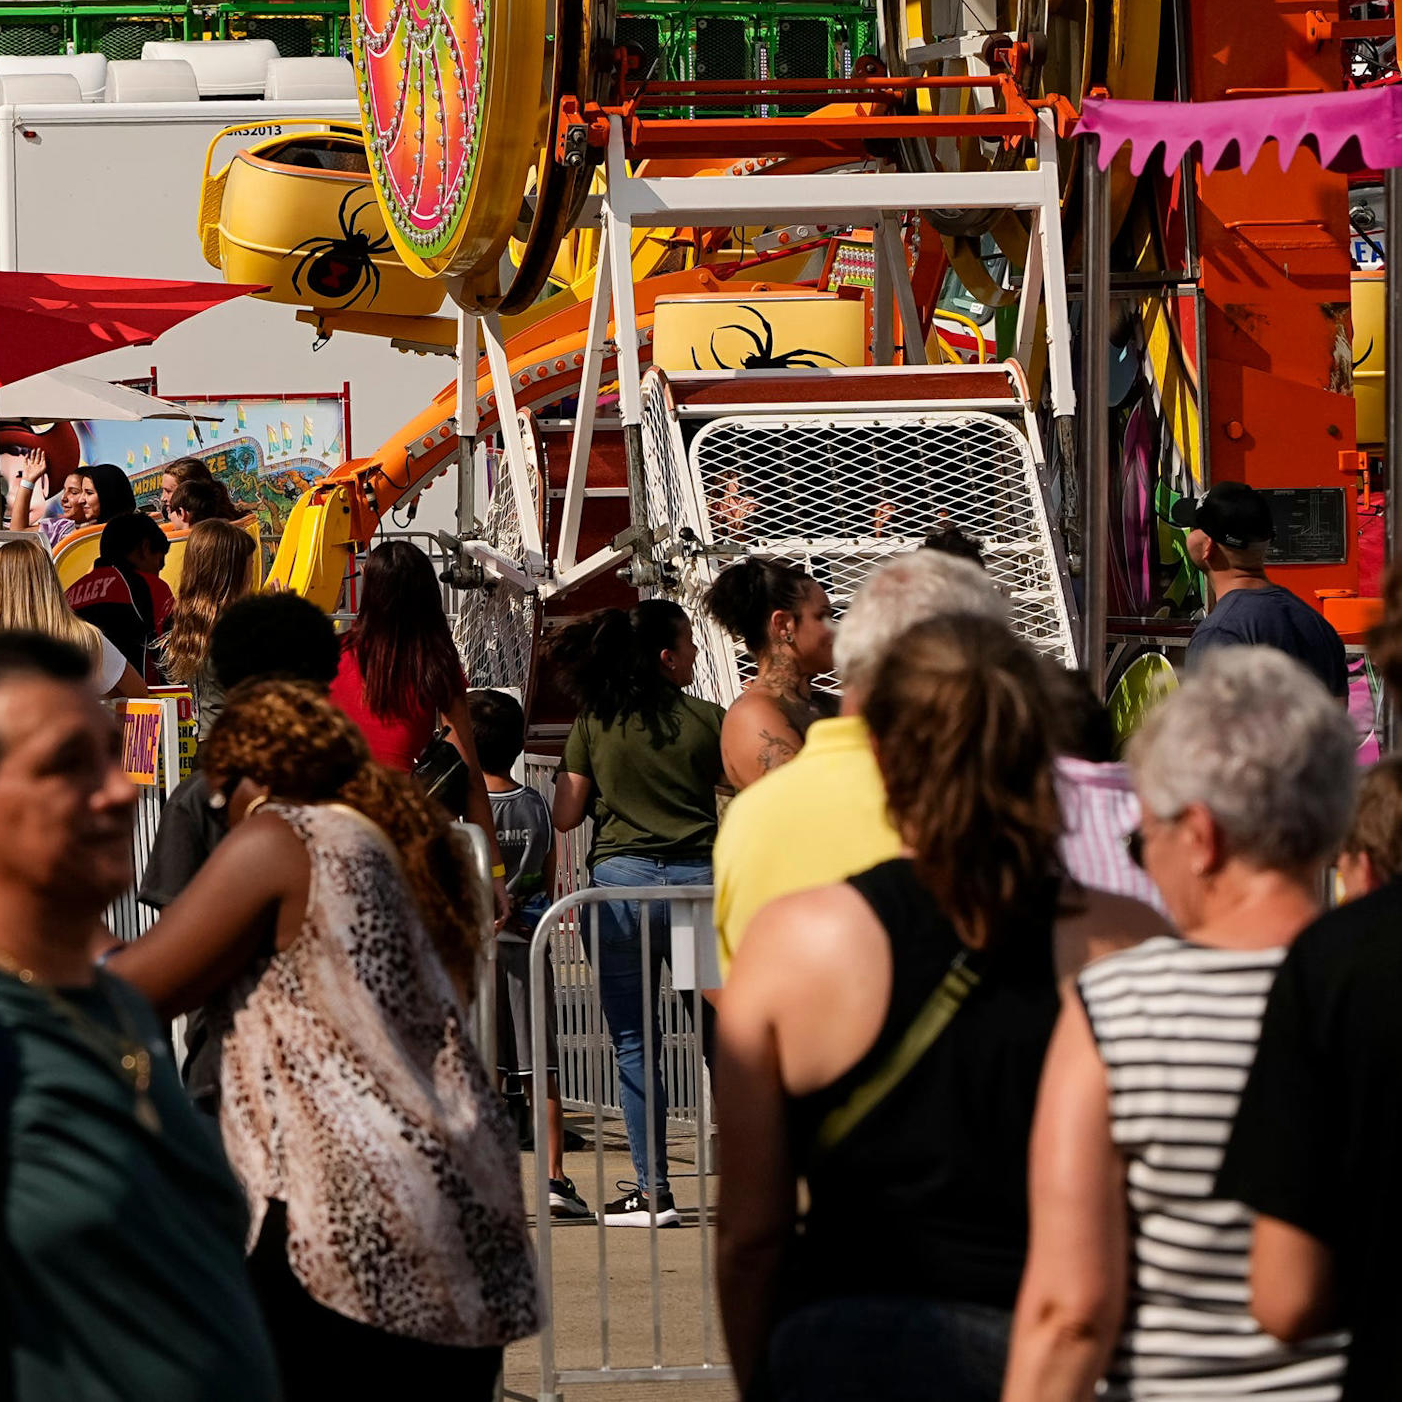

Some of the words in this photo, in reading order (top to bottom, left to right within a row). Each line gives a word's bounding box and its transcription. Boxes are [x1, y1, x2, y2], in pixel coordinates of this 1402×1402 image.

[66, 576, 116, 606] ALLEY
[123, 713, 160, 774] TRANCE
[496, 828, 531, 842] ONIC
